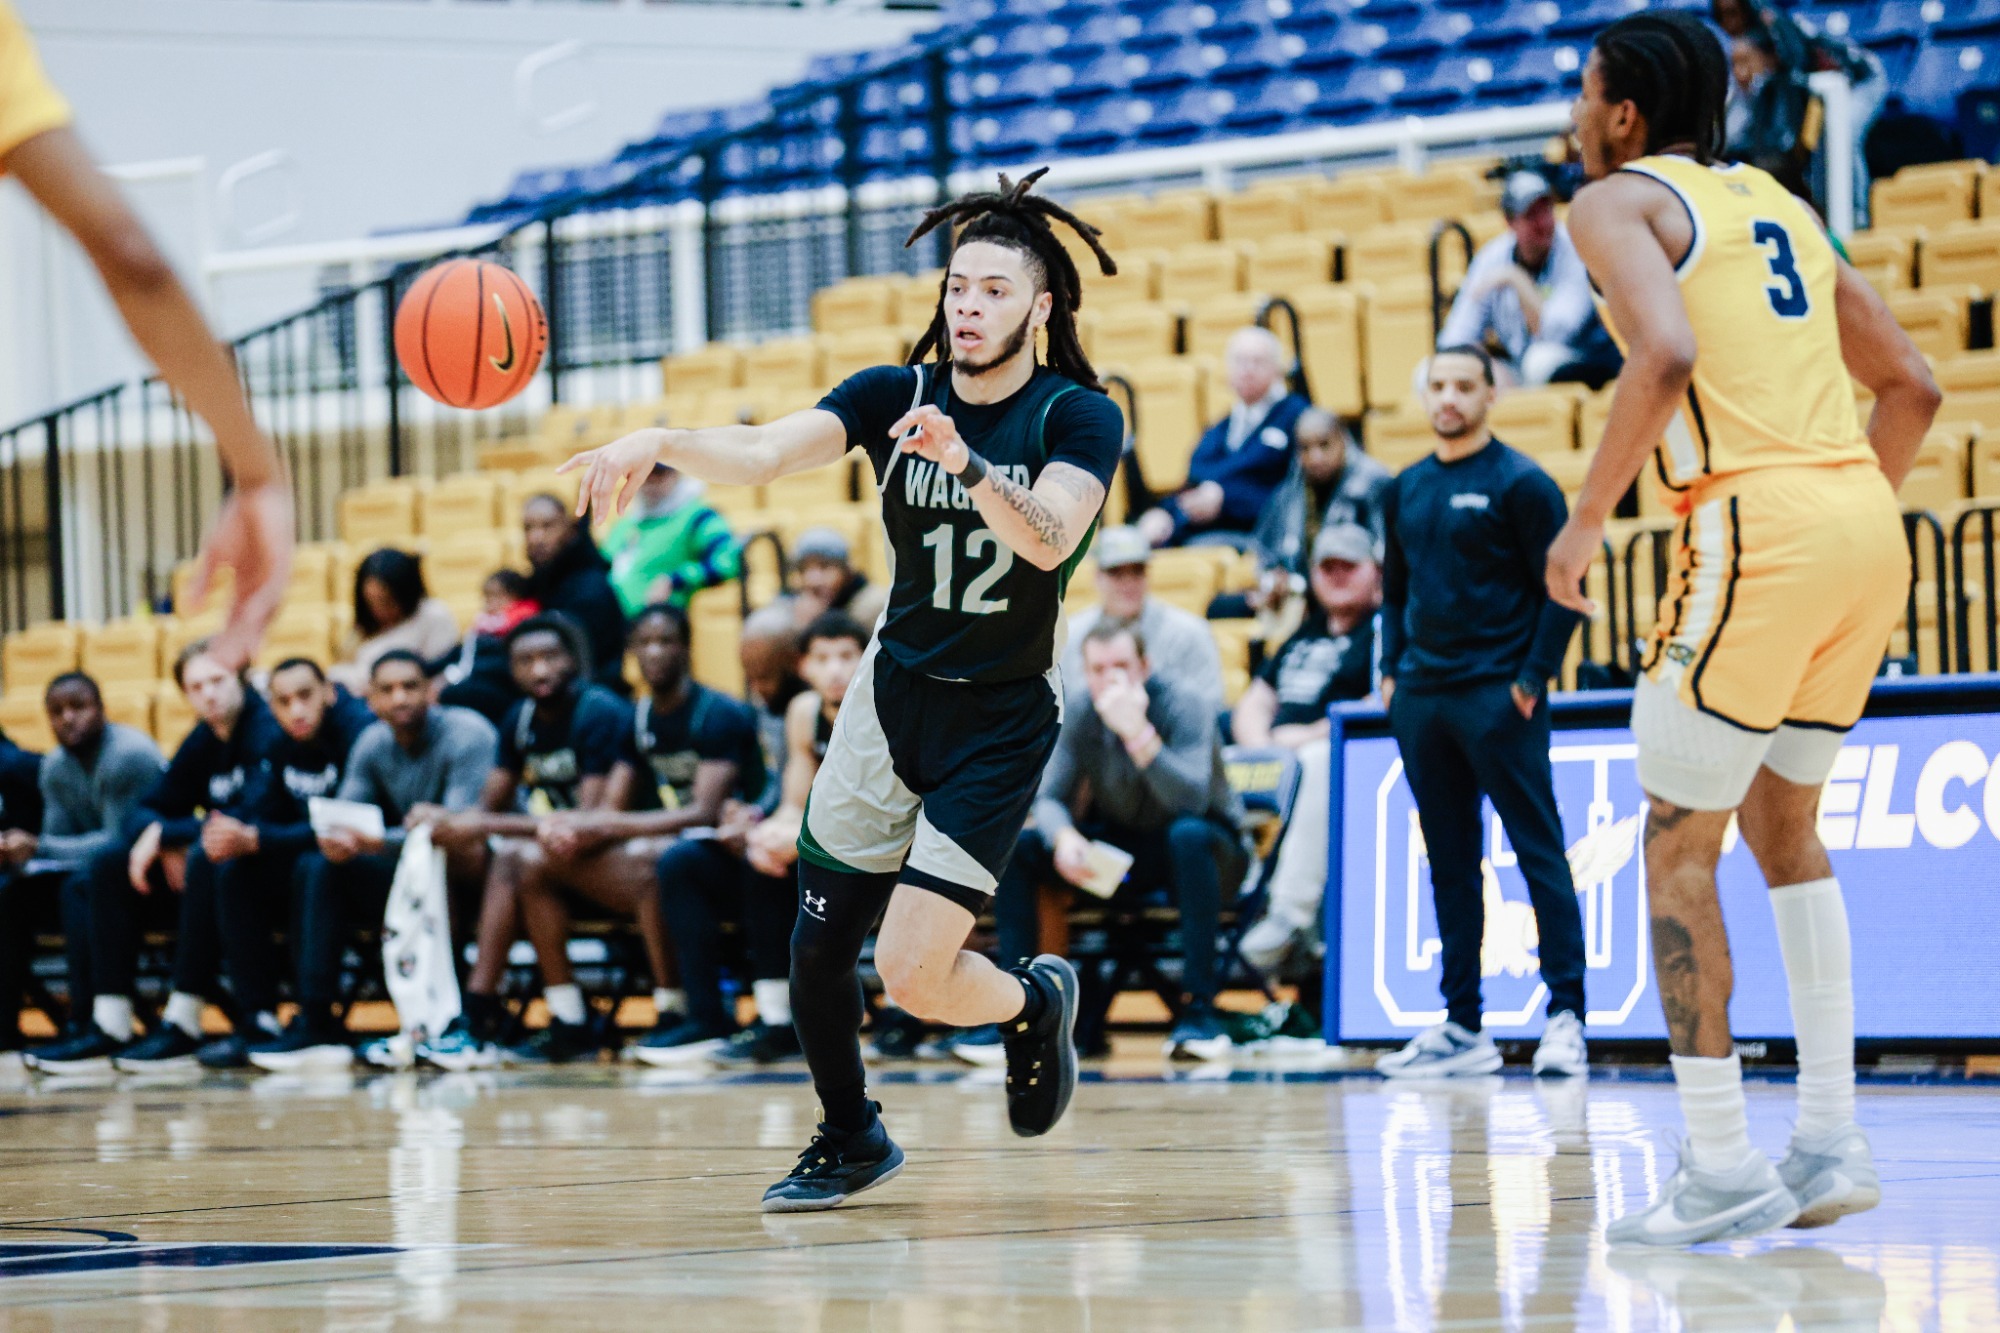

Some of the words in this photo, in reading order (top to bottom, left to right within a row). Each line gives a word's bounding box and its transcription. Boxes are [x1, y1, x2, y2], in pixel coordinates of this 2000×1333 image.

[1753, 219, 1811, 319] 3
[905, 458, 1031, 512] WAG
[922, 523, 1014, 615] 12
[1720, 739, 2000, 854] ELC
